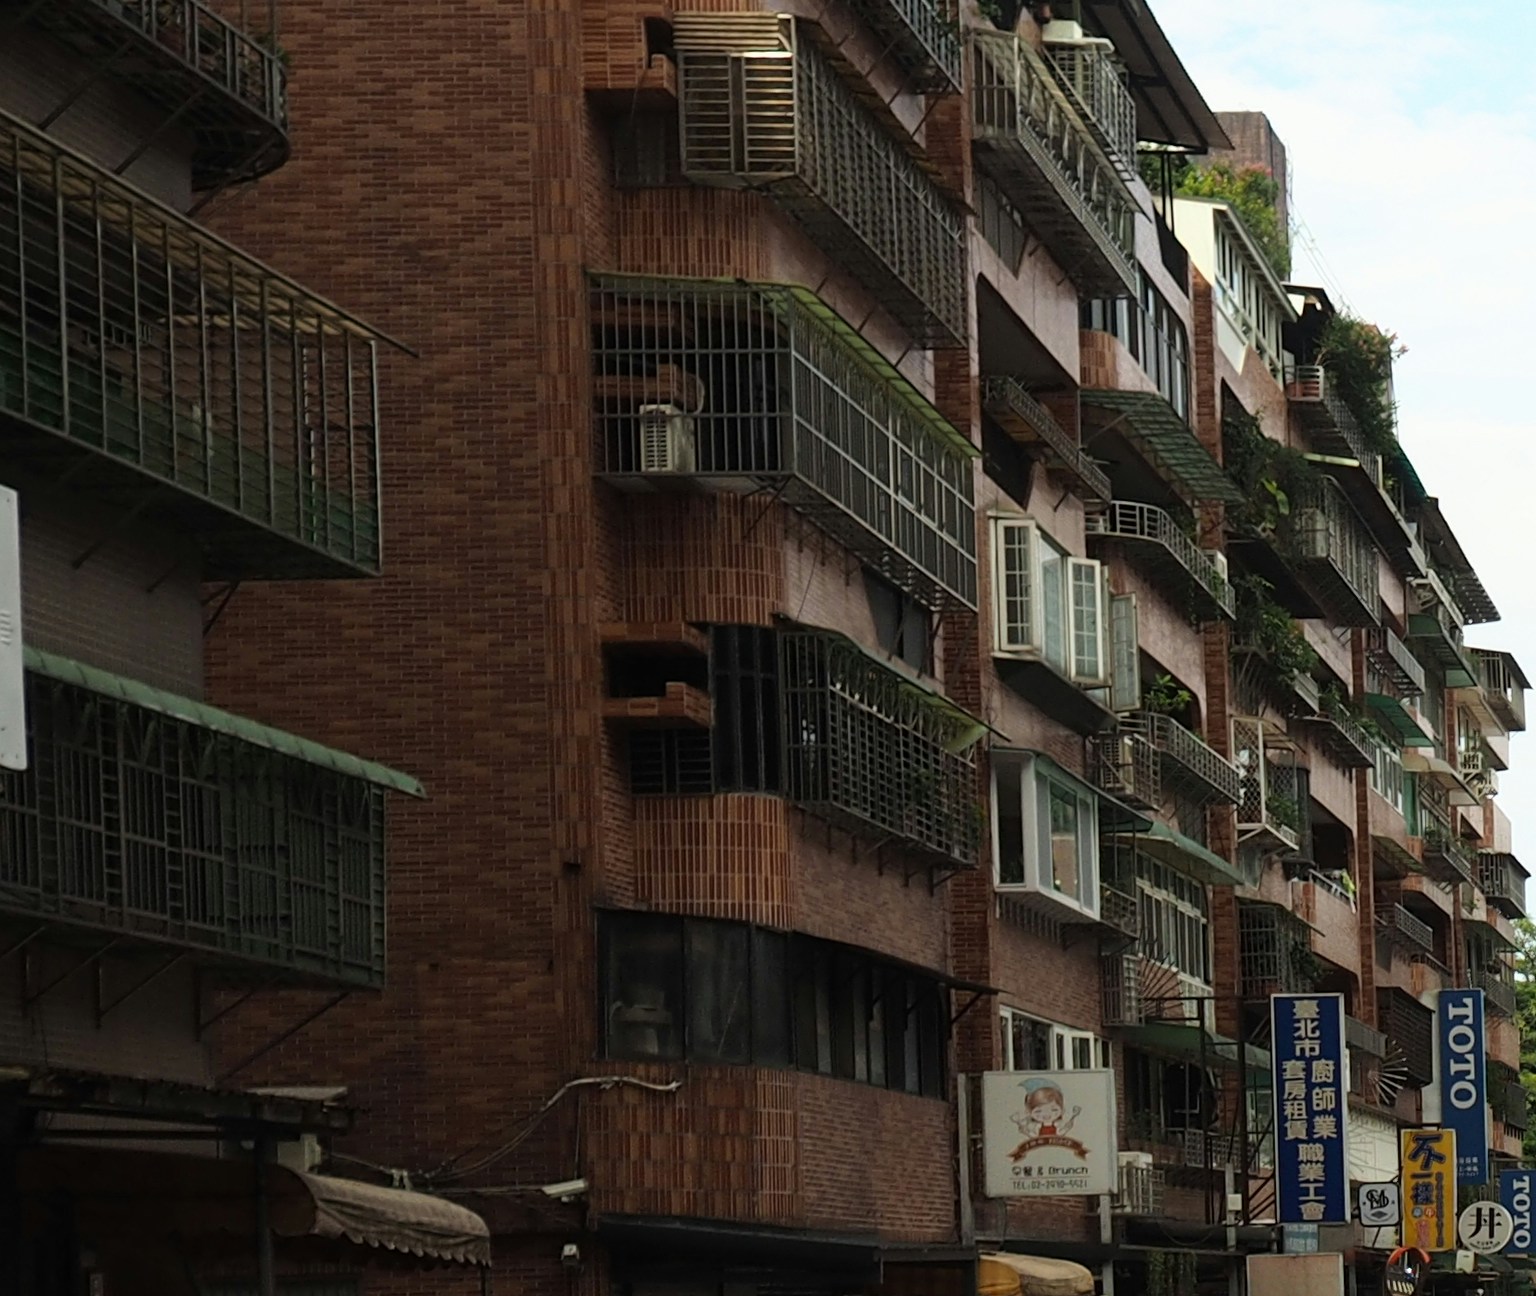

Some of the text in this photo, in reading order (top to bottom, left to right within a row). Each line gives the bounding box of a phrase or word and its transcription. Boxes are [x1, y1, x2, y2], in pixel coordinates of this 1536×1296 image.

[1448, 997, 1477, 1110] TOTO
[1048, 1166, 1088, 1175] Brunch
[1298, 1143, 1327, 1221] 職業工會
[1513, 1175, 1531, 1249] TOTO
